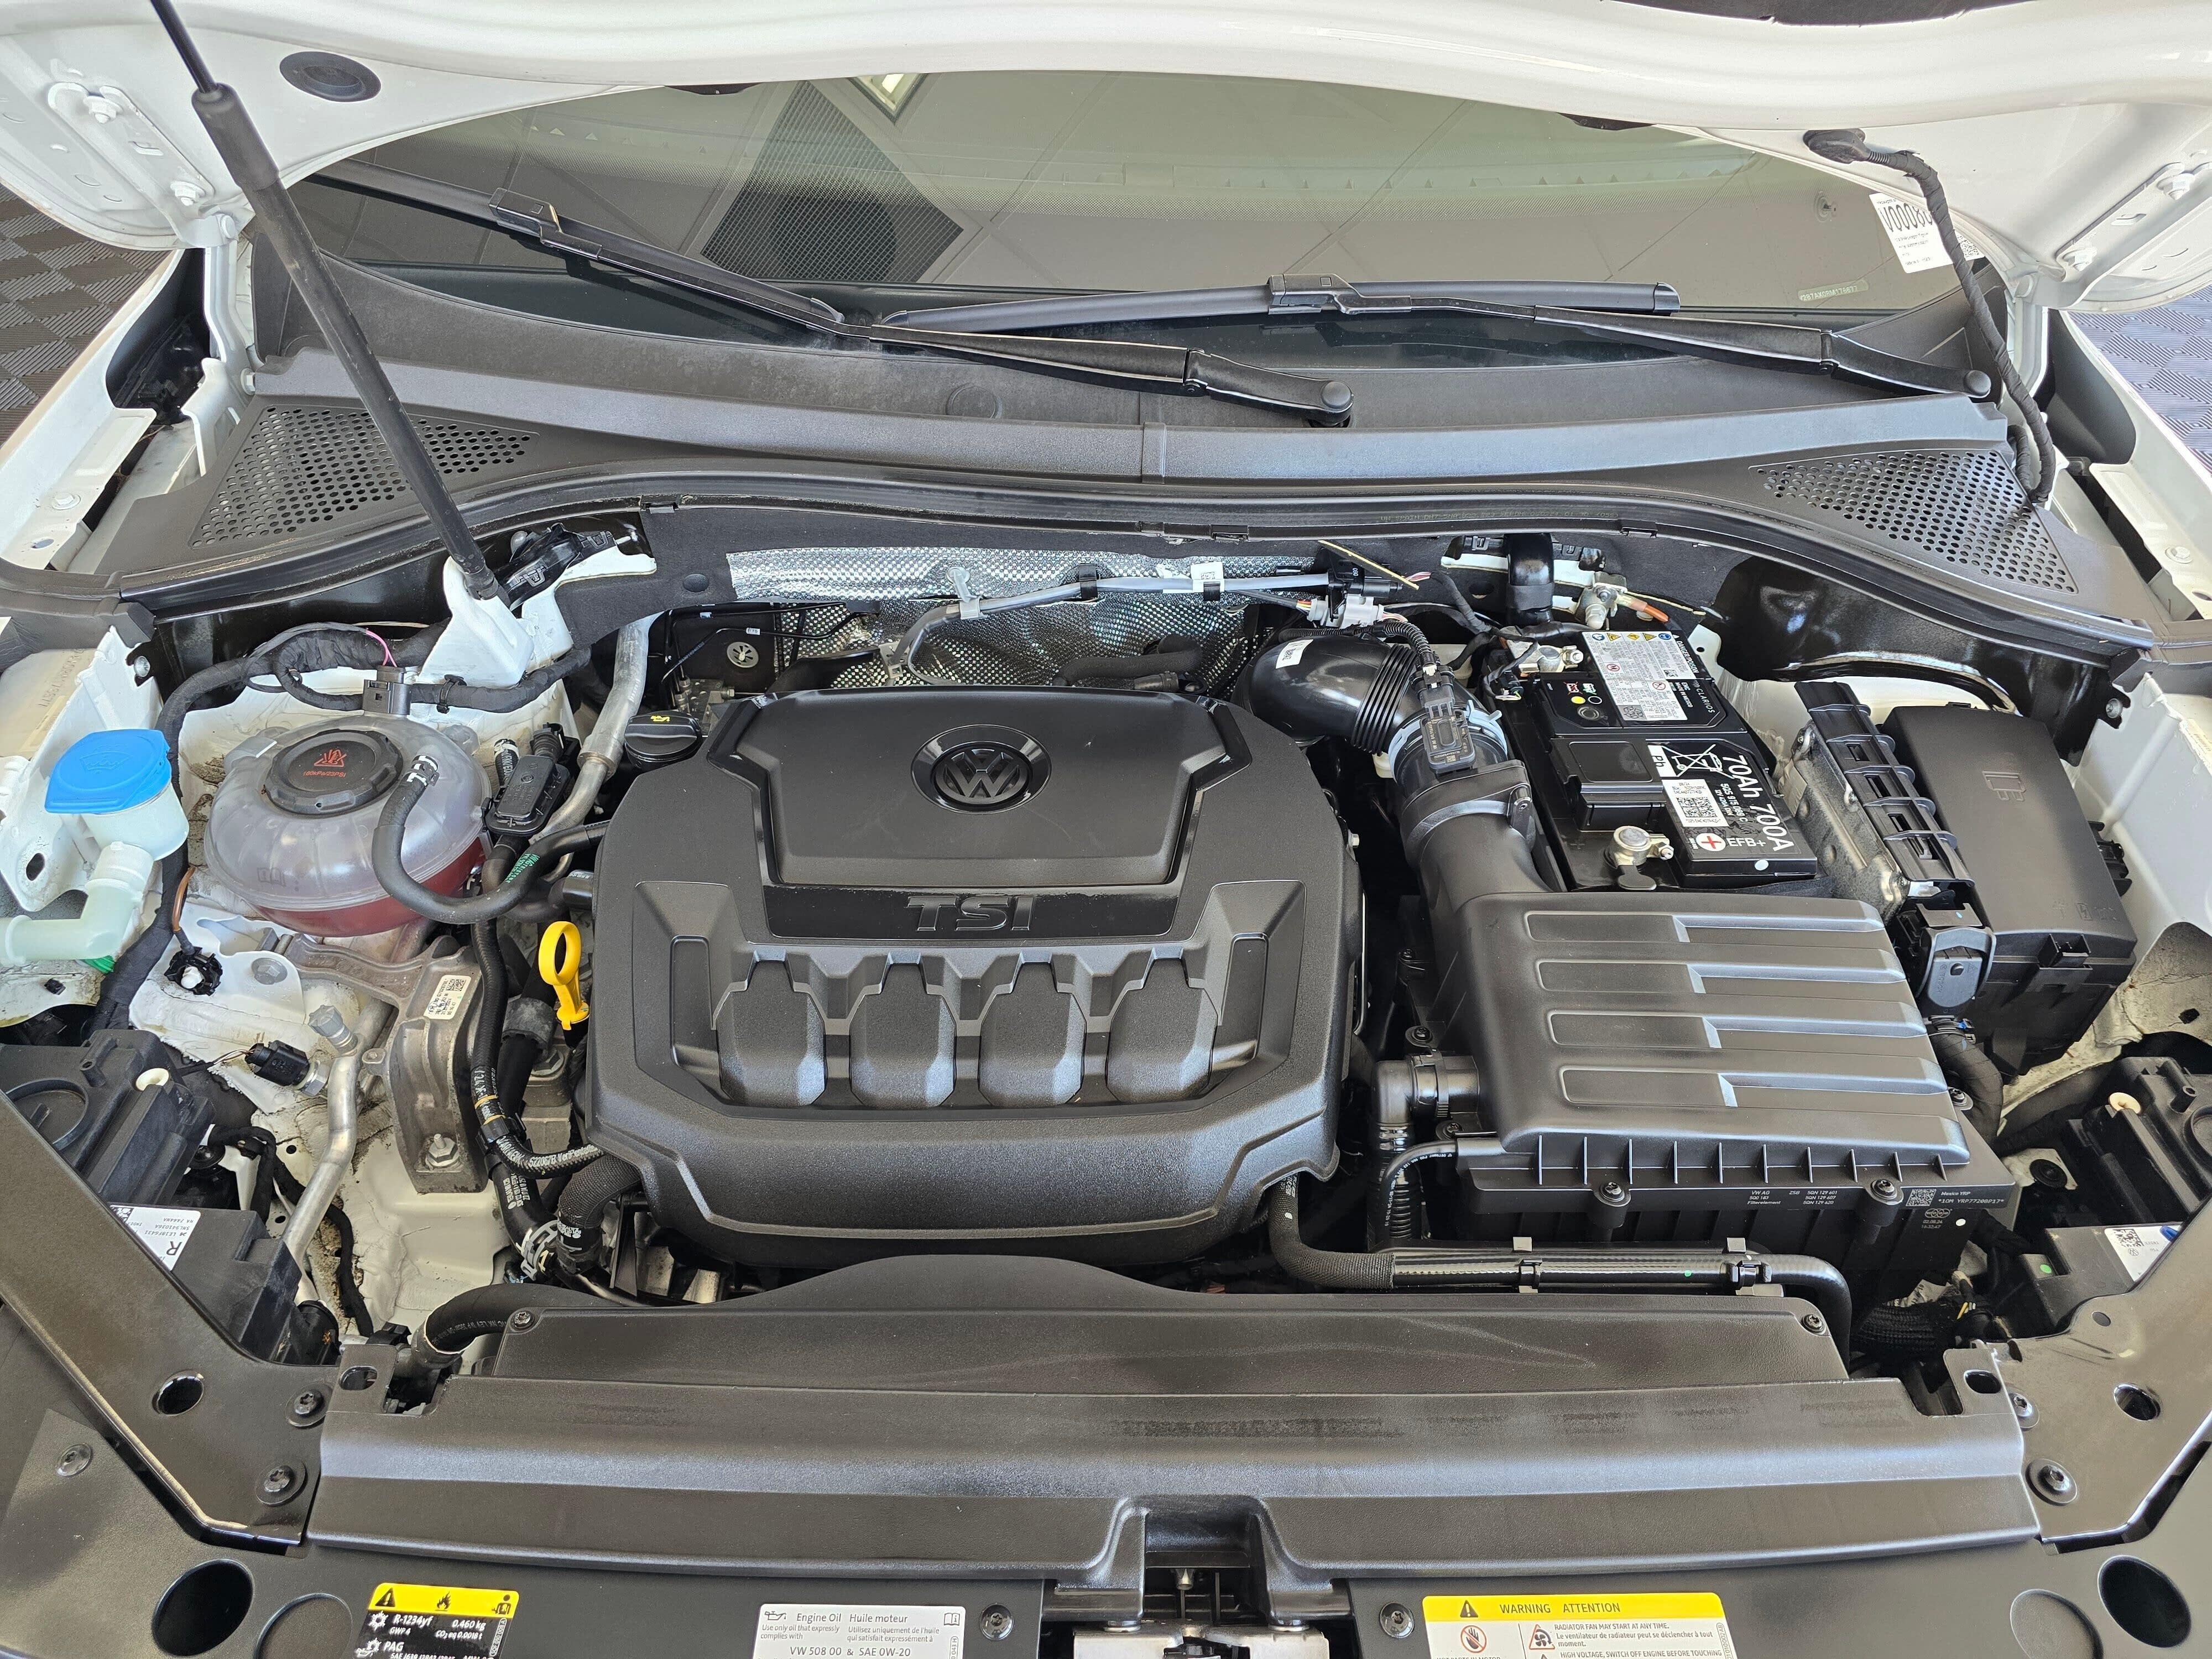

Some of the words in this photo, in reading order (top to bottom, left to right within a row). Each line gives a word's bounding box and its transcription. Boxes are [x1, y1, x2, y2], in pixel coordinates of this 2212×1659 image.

[1696, 688, 1715, 713] CLARIOS
[1652, 755, 1665, 768] Pb
[1722, 754, 1764, 798] 70Ah
[1749, 804, 1795, 852] 700A
[1726, 837, 1766, 847] EFB+
[907, 896, 1036, 931] TSI
[166, 1241, 182, 1256] R
[1499, 1604, 1551, 1614] WARNING
[1563, 1602, 1621, 1613] ATTENTION
[796, 1613, 827, 1624] Engine
[829, 1613, 842, 1622] Oil
[849, 1614, 873, 1623] Huile
[389, 1626, 406, 1635] GWP
[476, 1620, 487, 1631] kg
[760, 1632, 788, 1641] complies
[884, 1635, 928, 1643] expressément
[383, 1641, 405, 1652] PAG
[790, 1646, 807, 1655] VW
[809, 1647, 827, 1656] 508
[829, 1647, 842, 1656] 00
[859, 1648, 877, 1656] SAE
[879, 1648, 911, 1657] 0W-20
